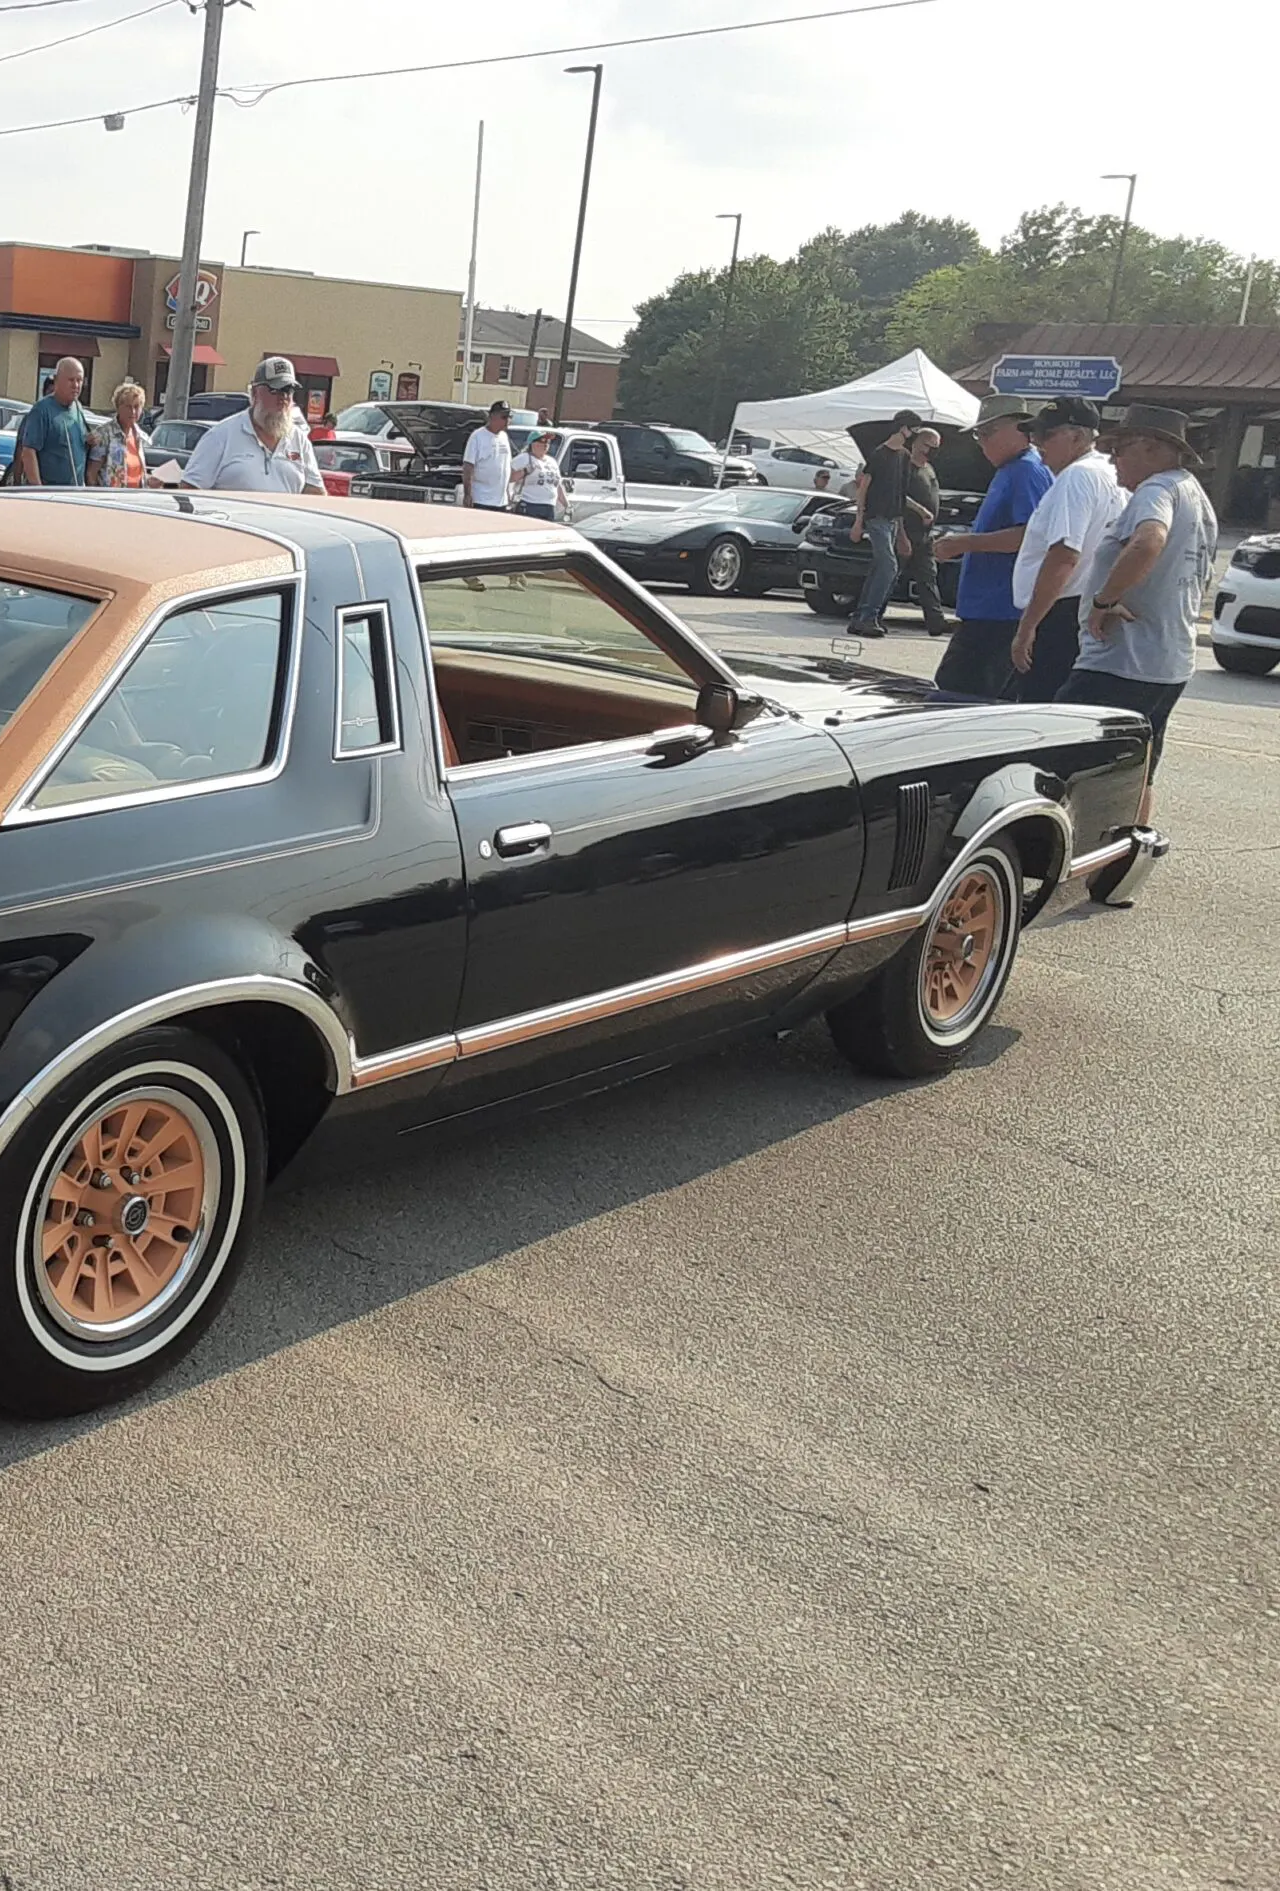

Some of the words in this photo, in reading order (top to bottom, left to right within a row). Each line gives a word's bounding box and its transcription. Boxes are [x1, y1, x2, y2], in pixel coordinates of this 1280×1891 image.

[1033, 360, 1080, 368] MONMOUTH
[996, 369, 1018, 377] FARM
[1035, 369, 1062, 378] HOME
[1100, 370, 1117, 379] LLC
